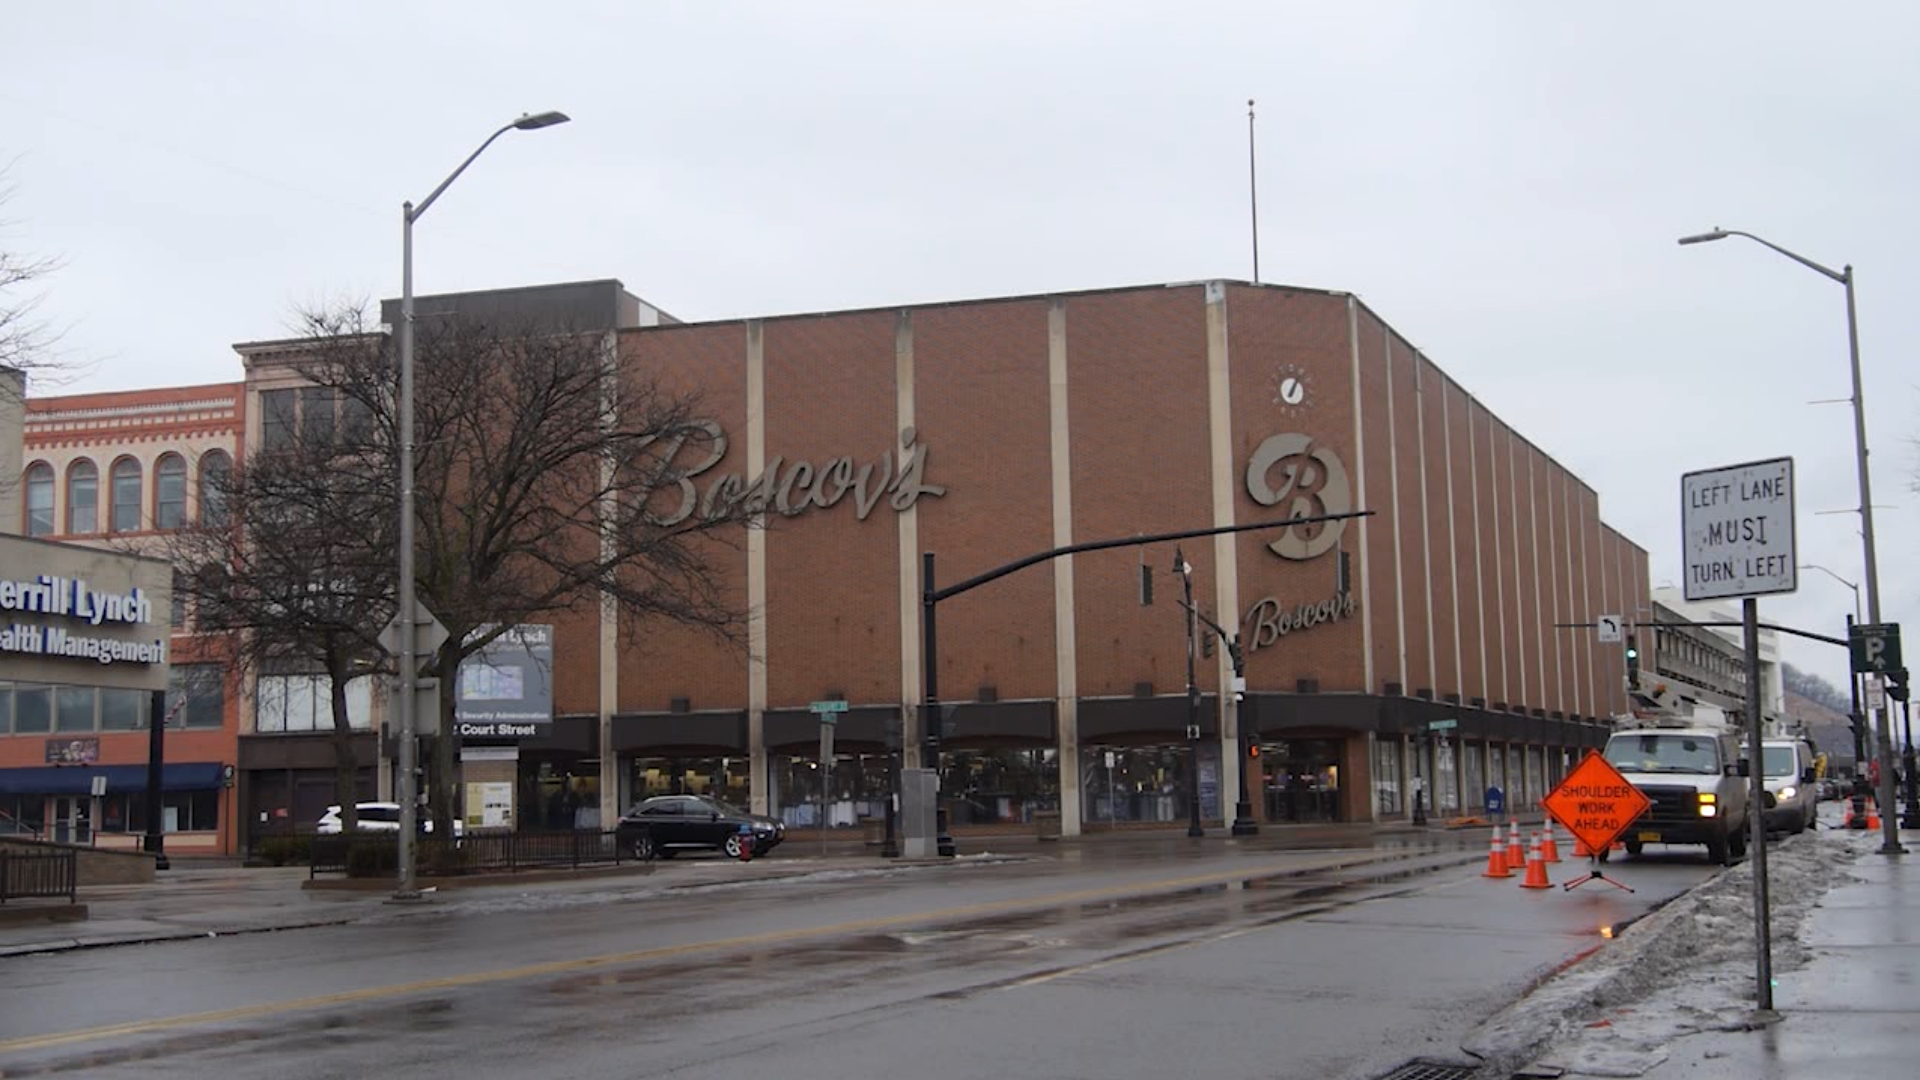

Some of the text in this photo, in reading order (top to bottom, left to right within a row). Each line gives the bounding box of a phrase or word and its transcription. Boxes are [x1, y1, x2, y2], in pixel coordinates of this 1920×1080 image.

[622, 417, 946, 527] Boscov's
[1247, 432, 1350, 560] B
[1692, 477, 1785, 508] LEFT LANE
[1708, 516, 1767, 546] MUST
[1692, 554, 1787, 584] TURN LEFT
[73, 579, 151, 625] Lynch
[0, 624, 165, 664] alth Management
[1865, 637, 1885, 662] P
[460, 724, 495, 735] Court
[498, 723, 535, 735] Street
[1562, 786, 1630, 798] SHOULDER
[1578, 801, 1616, 814] WORK
[1574, 818, 1620, 830] AHEAD
